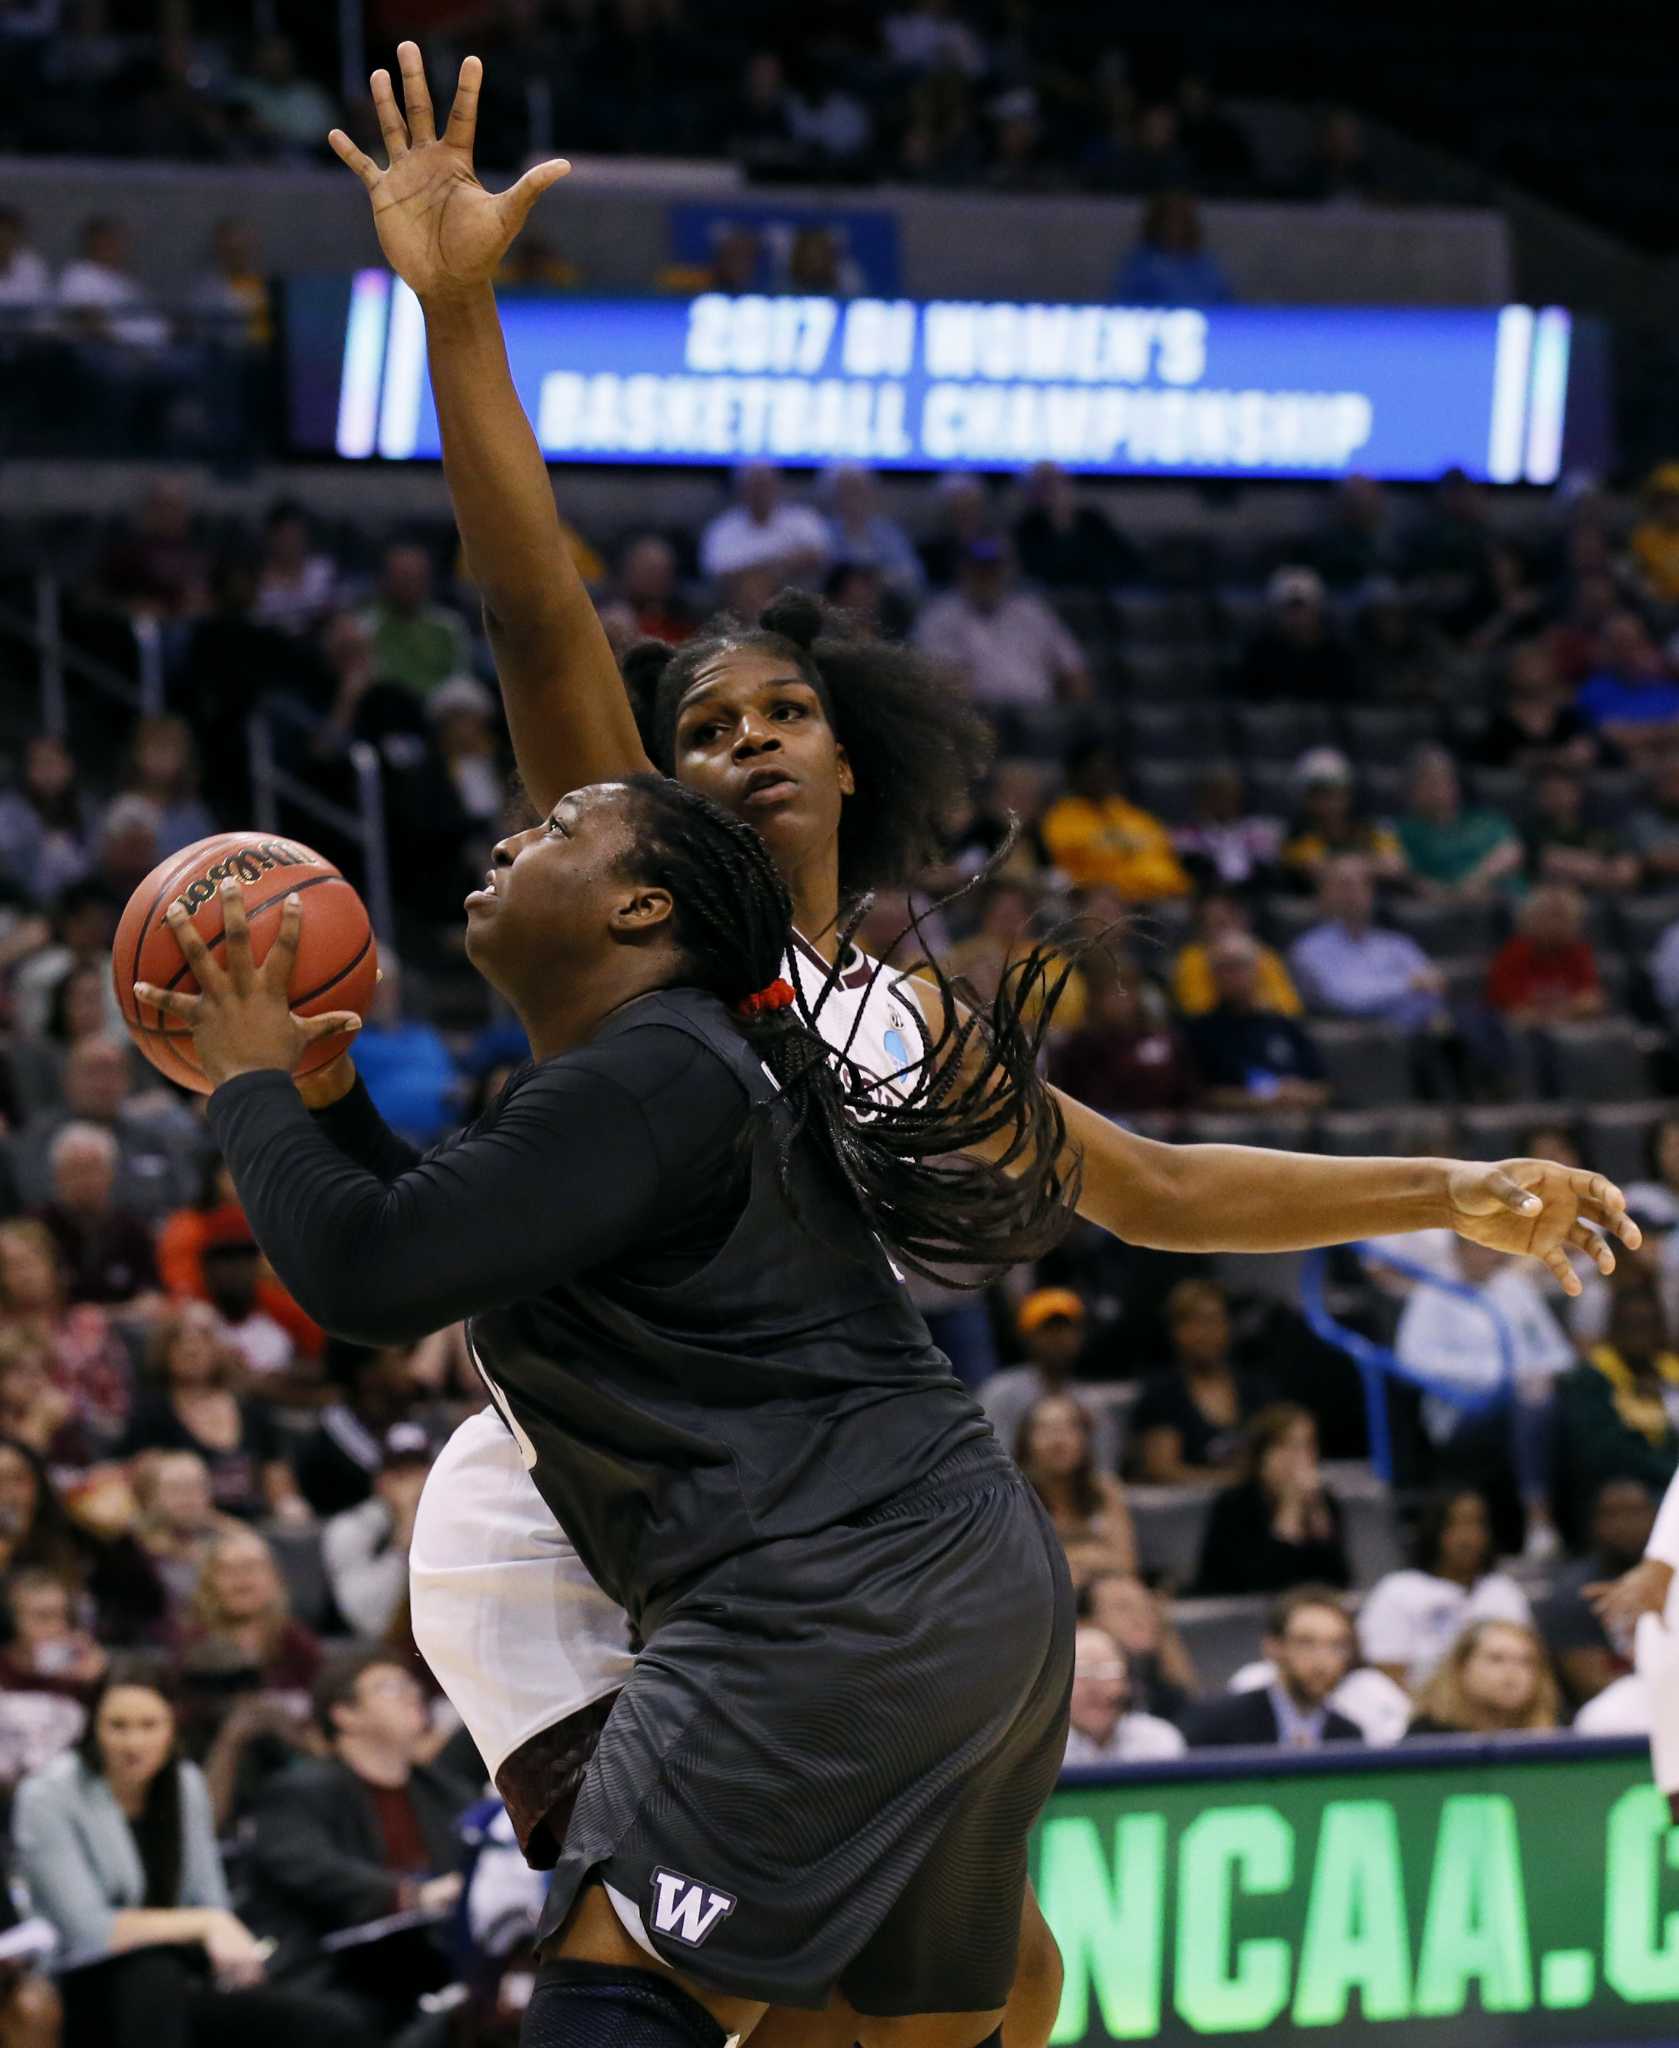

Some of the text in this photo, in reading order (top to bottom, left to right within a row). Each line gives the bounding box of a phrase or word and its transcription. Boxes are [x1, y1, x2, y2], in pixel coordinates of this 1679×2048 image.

[687, 294, 838, 375] 2017
[923, 302, 1208, 386] WOMEN'S
[538, 371, 1372, 469] BASKETBALL CHAMPIONSHIP
[654, 1870, 733, 1944] W
